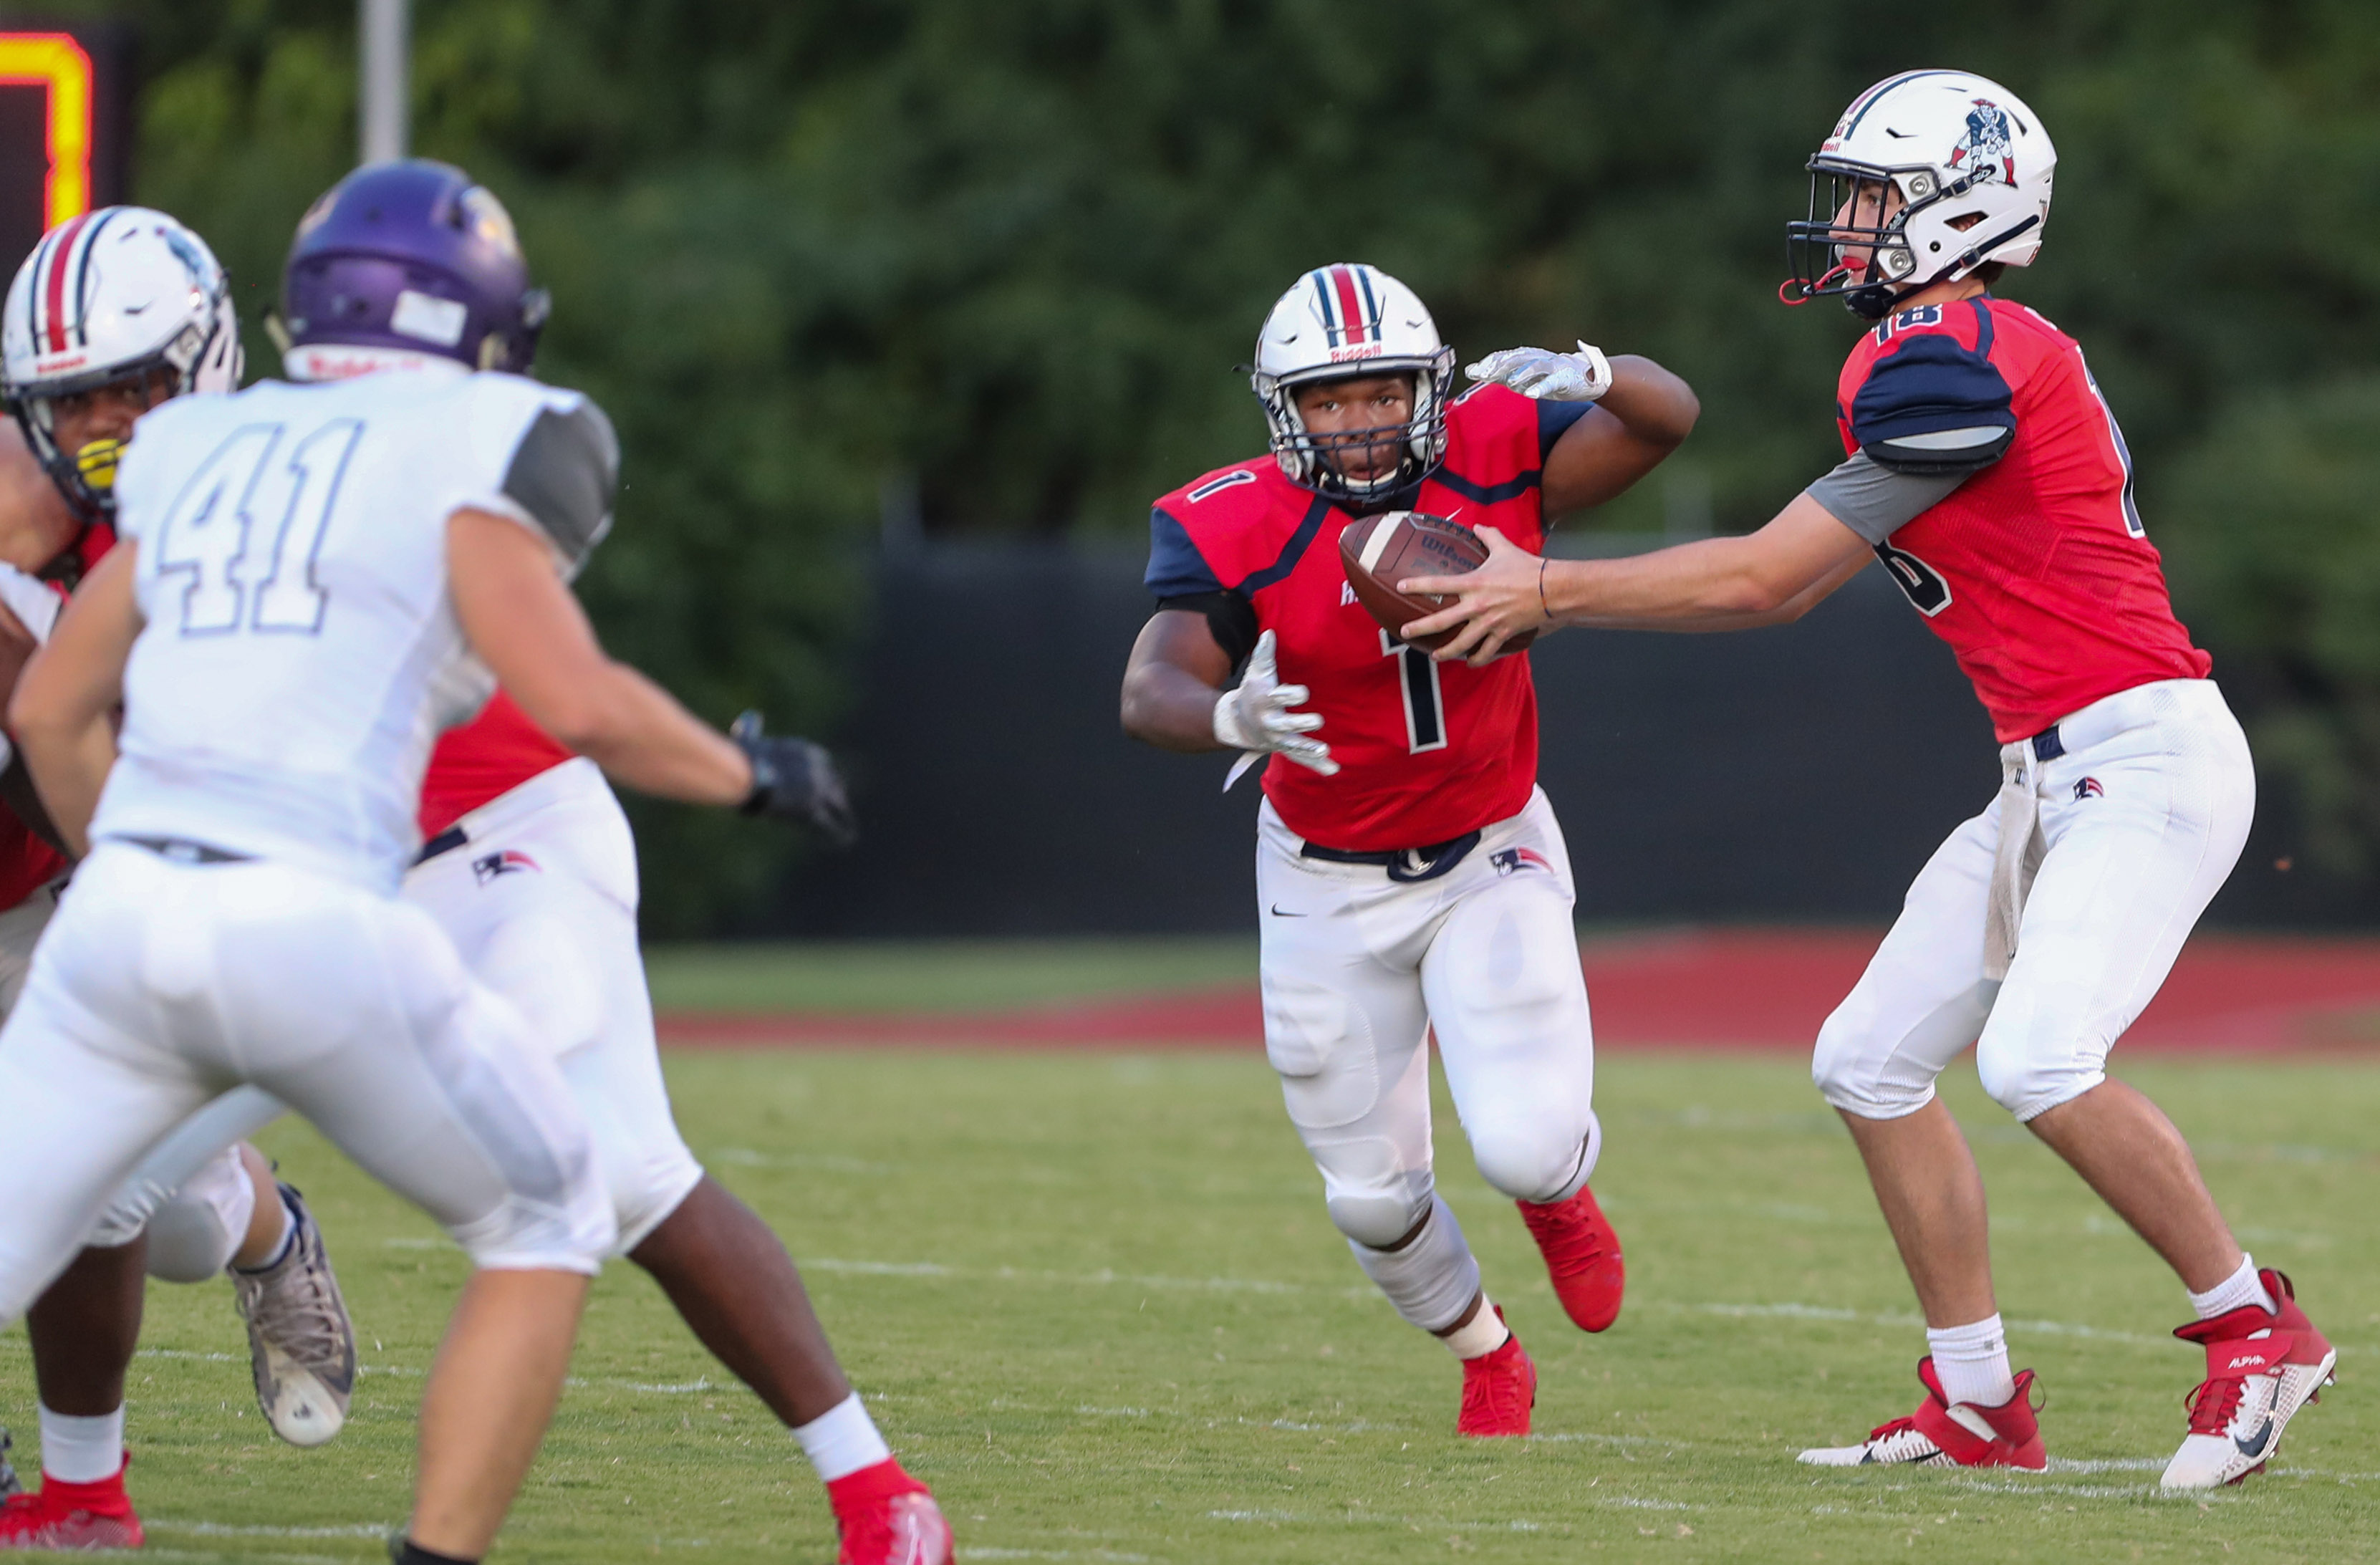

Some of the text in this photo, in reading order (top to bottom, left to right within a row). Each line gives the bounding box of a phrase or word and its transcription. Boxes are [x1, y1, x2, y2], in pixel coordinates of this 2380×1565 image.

[1871, 304, 1942, 347] 18
[1331, 344, 1382, 363] Riddell
[1186, 469, 1258, 504] 1
[156, 418, 367, 638] 41
[1379, 627, 1448, 755] 1
